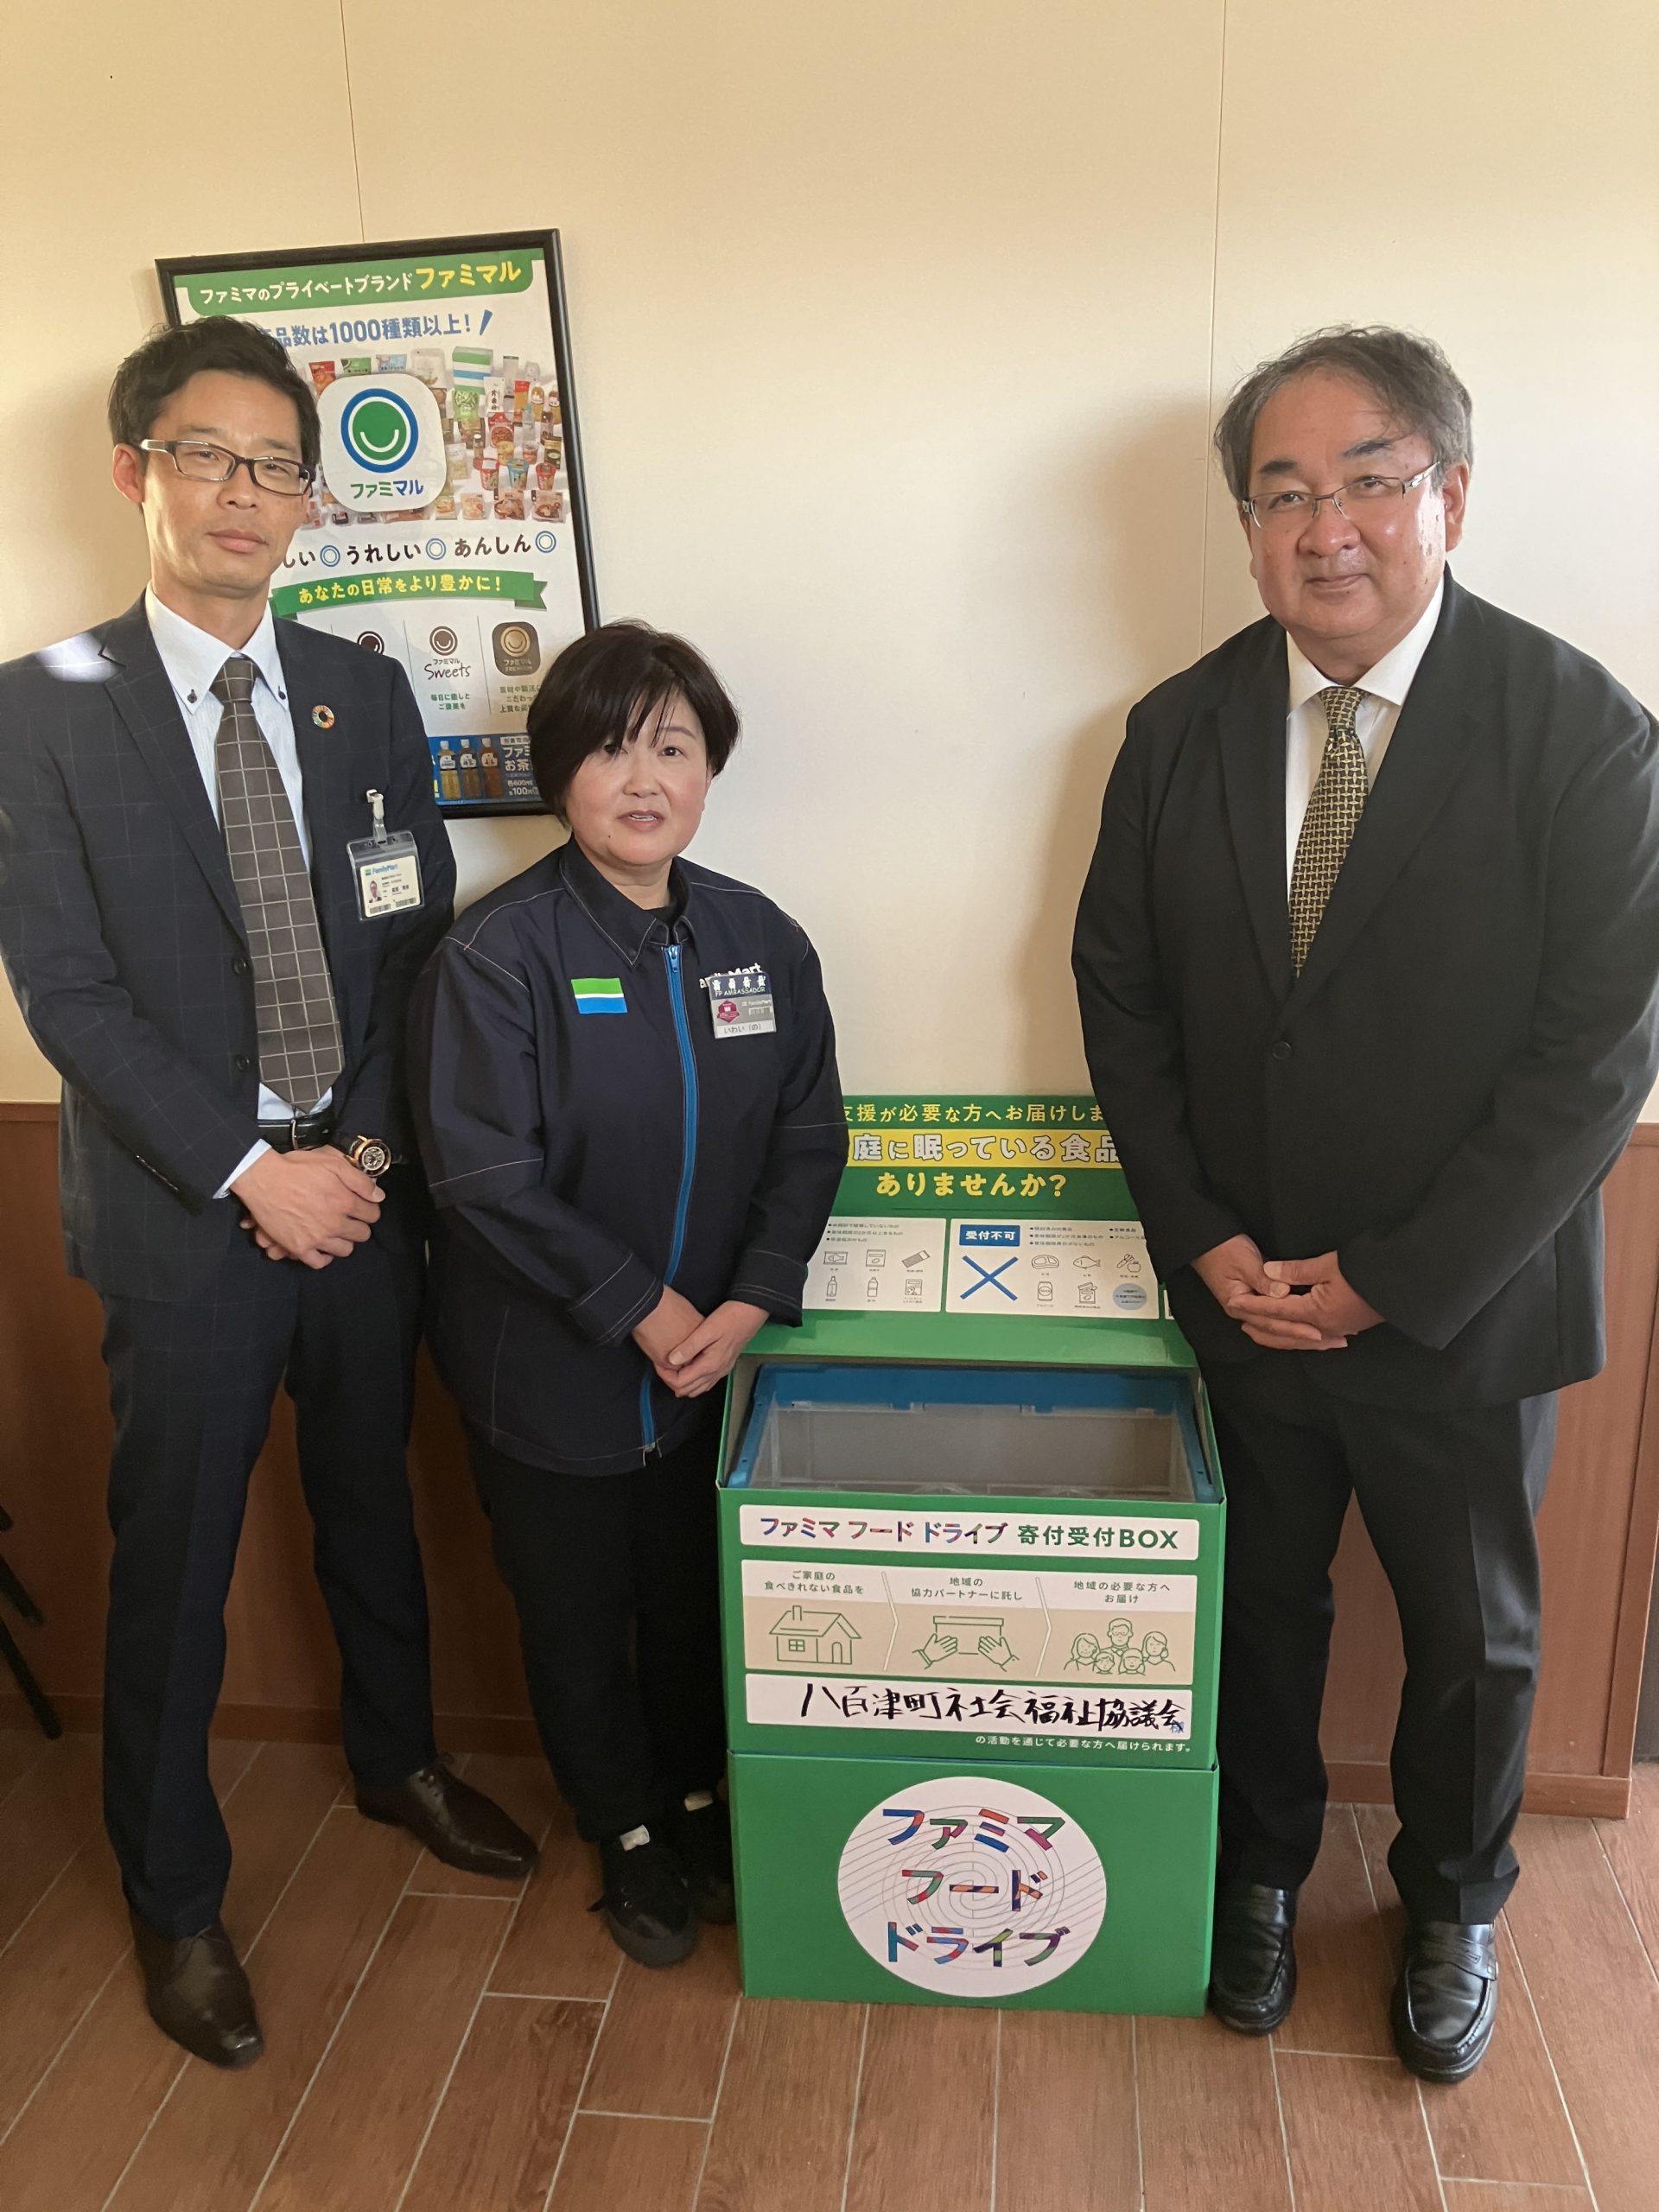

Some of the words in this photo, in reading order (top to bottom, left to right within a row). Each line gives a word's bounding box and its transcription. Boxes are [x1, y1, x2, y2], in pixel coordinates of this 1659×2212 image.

[200, 272, 413, 304] ファミマのプライベートブランド
[416, 261, 522, 289] ファミマル
[263, 311, 471, 347] 品数は1000種類以上!
[350, 479, 424, 499] ファミマル
[346, 541, 422, 566] うれしい
[454, 533, 531, 557] あんしん
[298, 574, 502, 603] あなたの日常をより豊かに!
[423, 663, 472, 681] Sweets
[852, 1133, 1121, 1163] 庭に眠っている食品
[875, 1172, 1067, 1198] ありませんか?
[964, 1230, 1016, 1241] 受付不可
[760, 1516, 841, 1540] ファミマ
[848, 1519, 913, 1542] フード
[924, 1522, 1009, 1546] ドライブ
[1016, 1524, 1179, 1551] 寄付受付BOX
[791, 1569, 836, 1581] ご家庭の
[949, 1576, 984, 1588] 地域の
[1073, 1580, 1172, 1592] 地域の必要な方へ
[764, 1582, 865, 1595] 食べきれない食品を
[911, 1588, 1023, 1601] 協力パートナーに託し
[1103, 1593, 1140, 1605] お届け
[800, 1682, 1184, 1732] 八百津町社会福祉協議会
[976, 1734, 1192, 1753] の活動を通じて必要な方へ届けられます。
[882, 1808, 1066, 1853] ファミマ
[901, 1869, 1049, 1912] フード
[887, 1921, 1071, 1968] ドライブ
